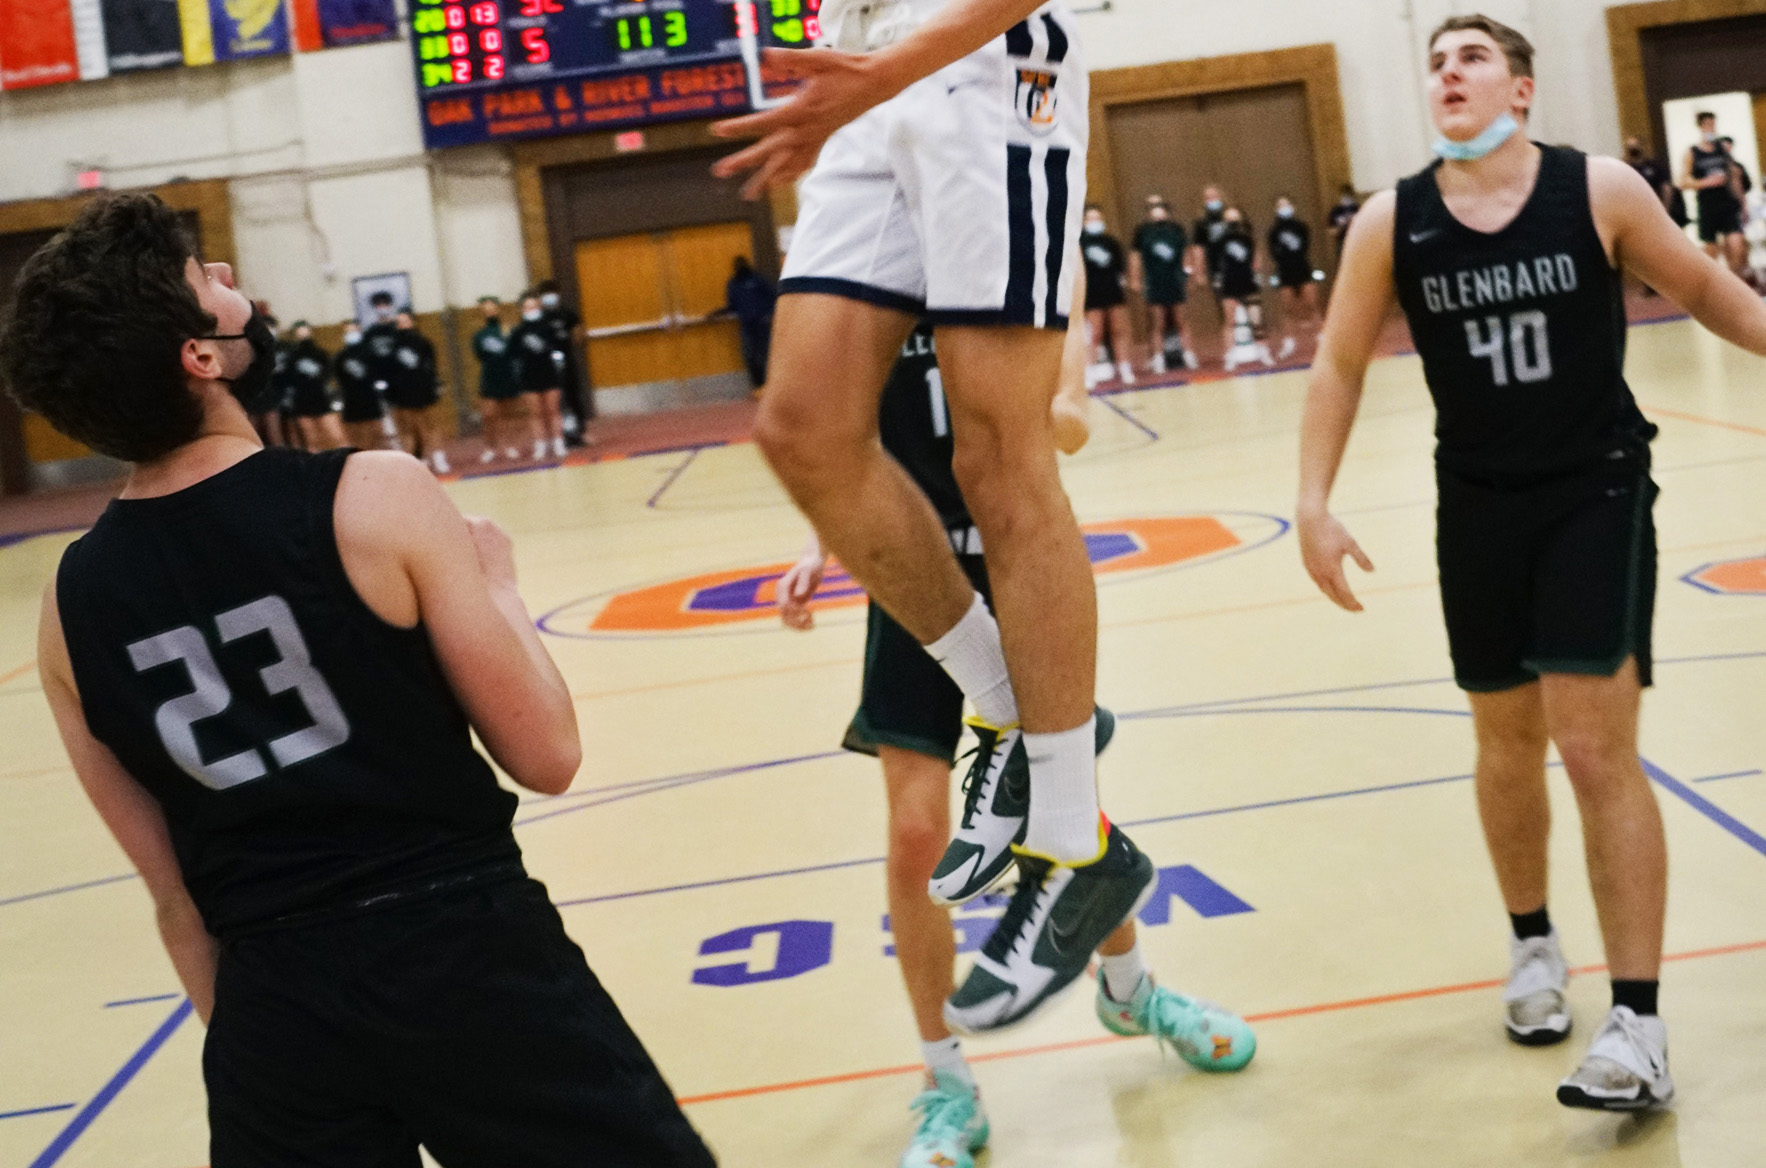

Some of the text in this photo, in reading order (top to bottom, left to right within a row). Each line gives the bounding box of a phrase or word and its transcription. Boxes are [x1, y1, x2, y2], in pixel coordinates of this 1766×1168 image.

[443, 4, 466, 30] 0
[469, 1, 499, 27] 13
[446, 32, 470, 57] 0
[478, 28, 502, 53] 0
[520, 27, 550, 63] 5
[450, 58, 472, 84] 2
[483, 54, 505, 79] 2
[427, 98, 473, 126] OAK
[483, 89, 543, 119] PARK
[581, 75, 650, 106] RIVER
[661, 62, 745, 96] FOREST
[1421, 252, 1578, 314] GLENBARD
[1464, 309, 1552, 386] 40
[126, 594, 351, 790] 23
